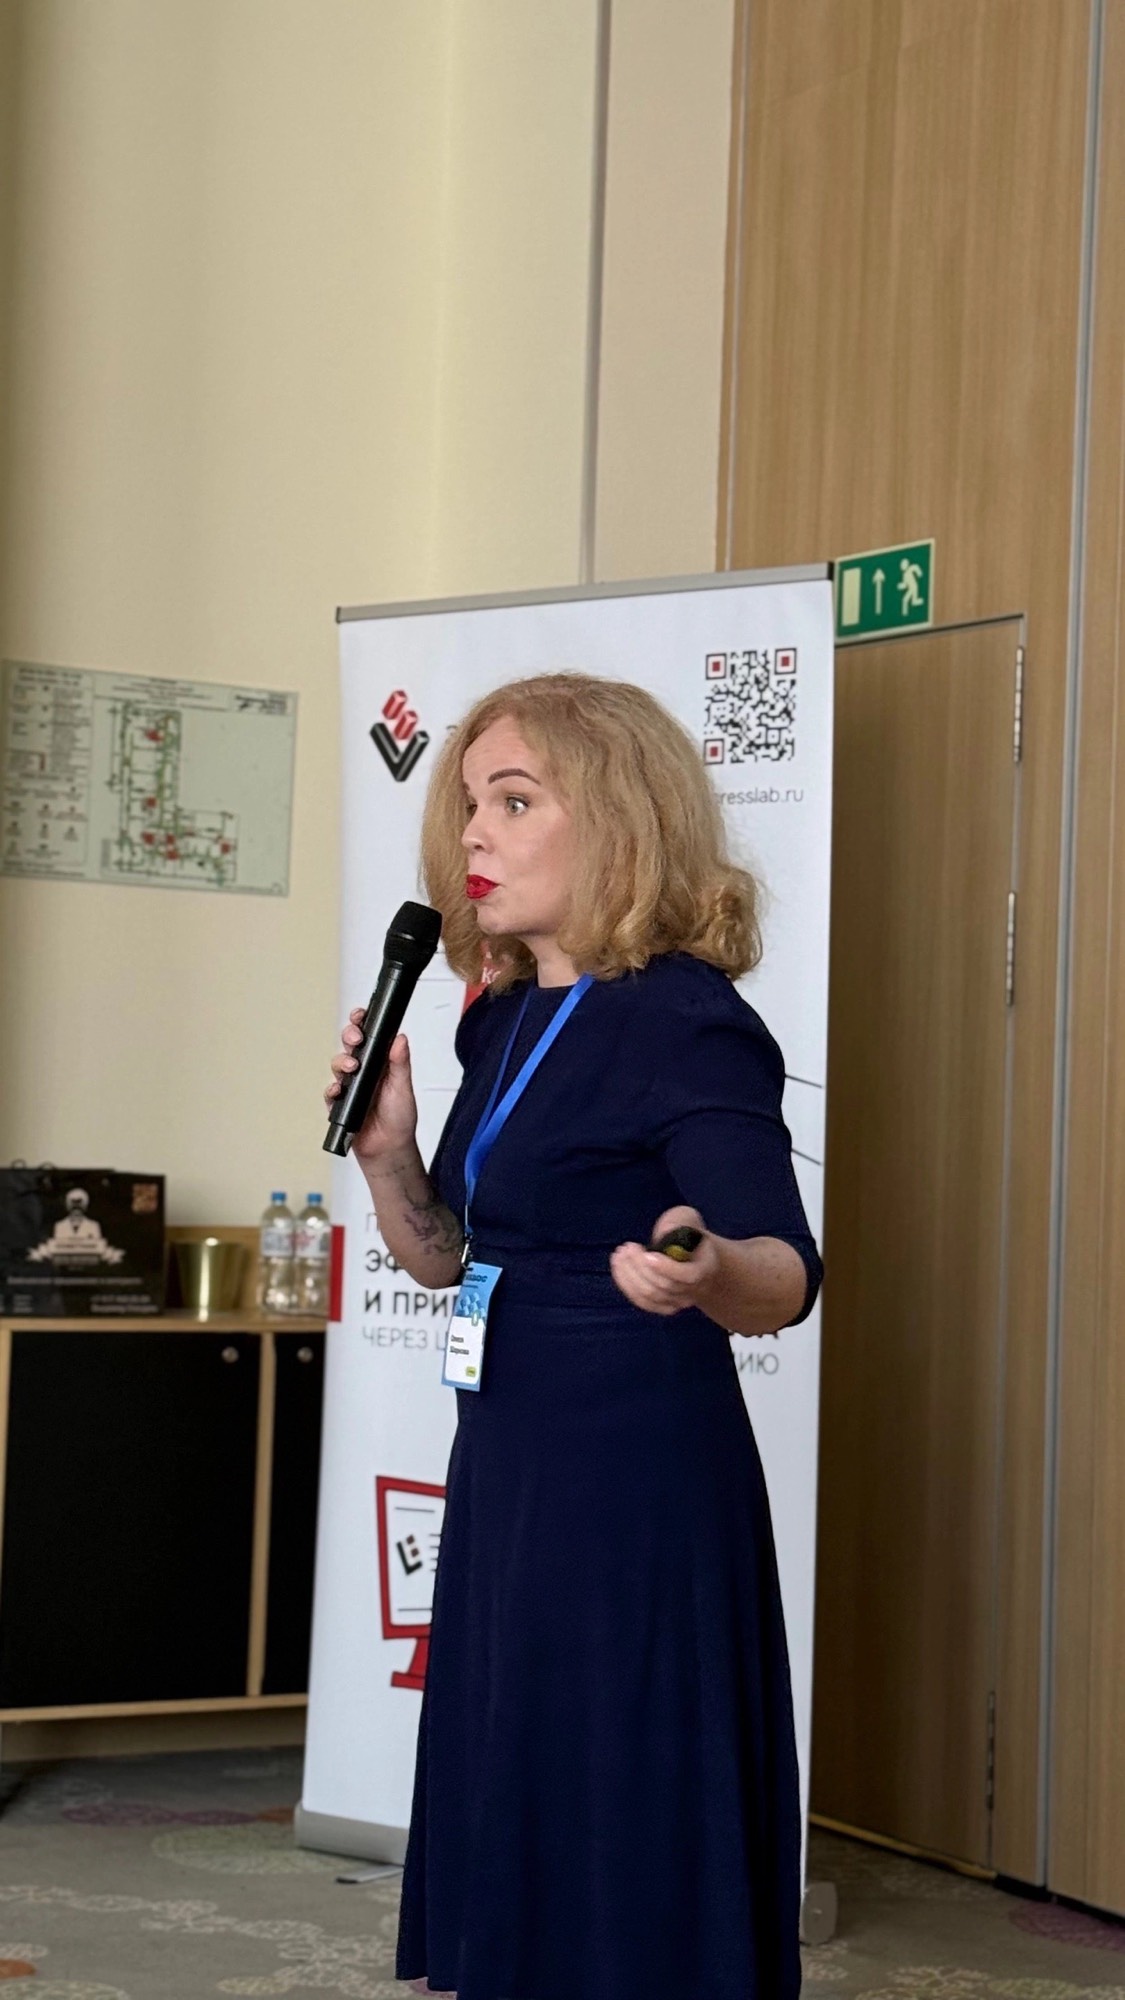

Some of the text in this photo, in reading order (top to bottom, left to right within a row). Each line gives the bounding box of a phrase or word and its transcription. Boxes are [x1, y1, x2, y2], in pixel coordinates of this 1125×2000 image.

[714, 787, 805, 805] resslab.ru
[364, 1290, 381, 1314] И
[362, 1325, 428, 1351] ЧЕРЕЗ
[735, 1352, 779, 1375] ИЮ
